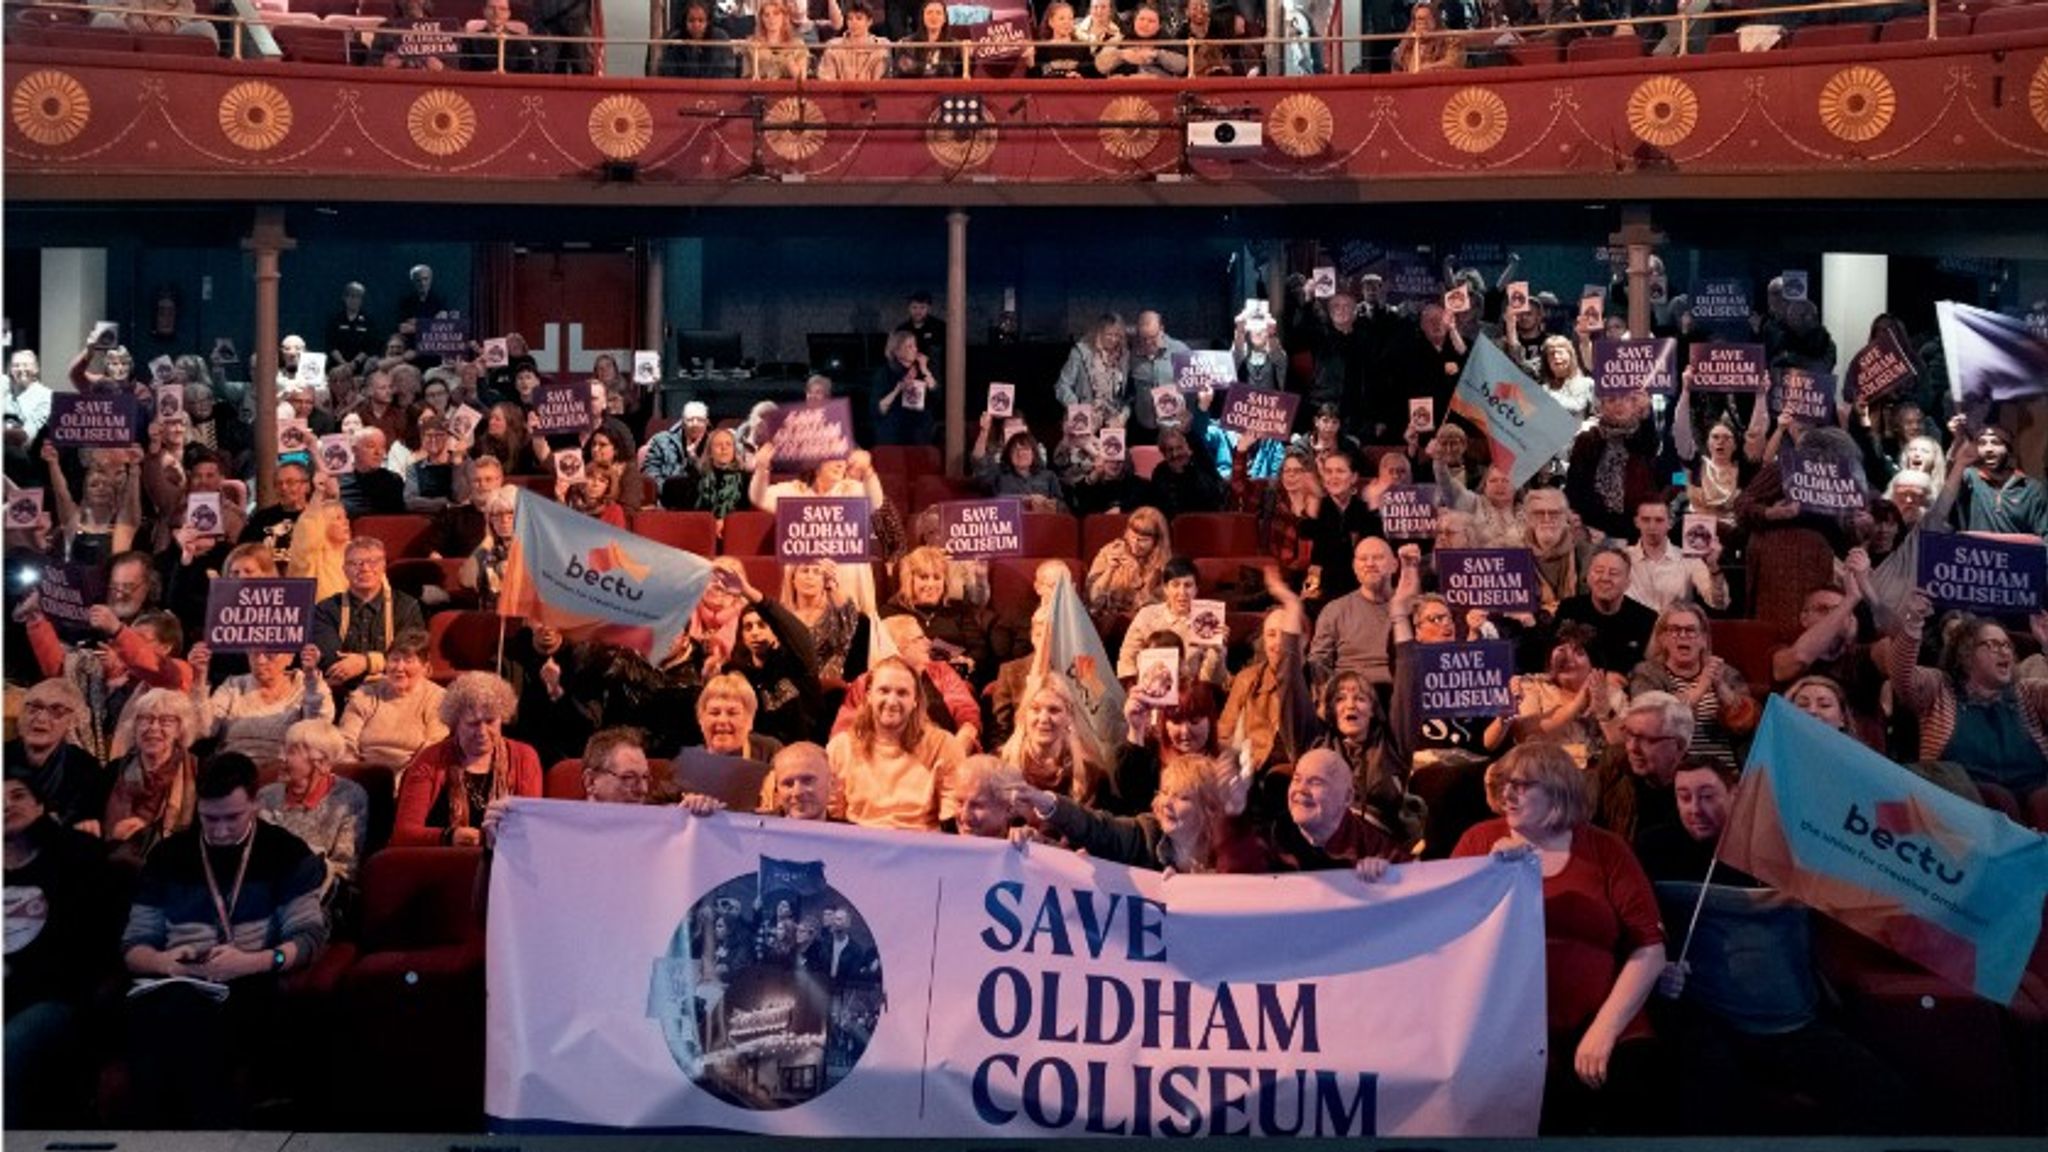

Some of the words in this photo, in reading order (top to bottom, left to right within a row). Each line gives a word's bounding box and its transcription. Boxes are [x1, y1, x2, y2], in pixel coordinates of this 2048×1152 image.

[1617, 344, 1653, 359] SAVE
[1711, 349, 1744, 361] SAVE
[1699, 362, 1755, 373] OLDHAM
[1694, 373, 1759, 386] COLISEUM
[74, 401, 114, 414] SAVE
[1247, 392, 1279, 407] SAVE
[60, 414, 125, 427] OLDHAM
[55, 428, 130, 441] COLISEUM
[1803, 459, 1839, 478] SAVE
[1793, 471, 1854, 493] OLDHAM
[1790, 486, 1864, 508] COLISEUM
[803, 505, 845, 522] SAVE
[962, 506, 998, 522] SAVE
[1383, 504, 1431, 518] LDHAM
[788, 522, 859, 539] OLDHAM
[950, 521, 1013, 538] OLDHAM
[781, 539, 864, 555] COLISEUM
[945, 536, 1018, 553] COLISEUM
[1463, 557, 1505, 574] SAVE
[1955, 546, 2009, 569] SAVE
[565, 554, 644, 602] bectu
[1448, 573, 1522, 589] OLDHAM
[1933, 562, 2030, 589] OLDHAM
[238, 587, 285, 605] SAVE
[1446, 589, 1529, 606] COLISEUM
[1926, 581, 2037, 606] COLISEUM
[220, 606, 300, 624] OLDHAM
[211, 626, 304, 643] COLISEUM
[1439, 650, 1485, 671] SAVE
[1424, 668, 1502, 690] OLDHAM
[1421, 687, 1510, 709] COLISEUM
[1844, 803, 1965, 884] bectu
[980, 880, 1168, 963] SAVE
[977, 965, 1321, 1053] OLDHAM
[971, 1053, 1379, 1139] COLISEUM
